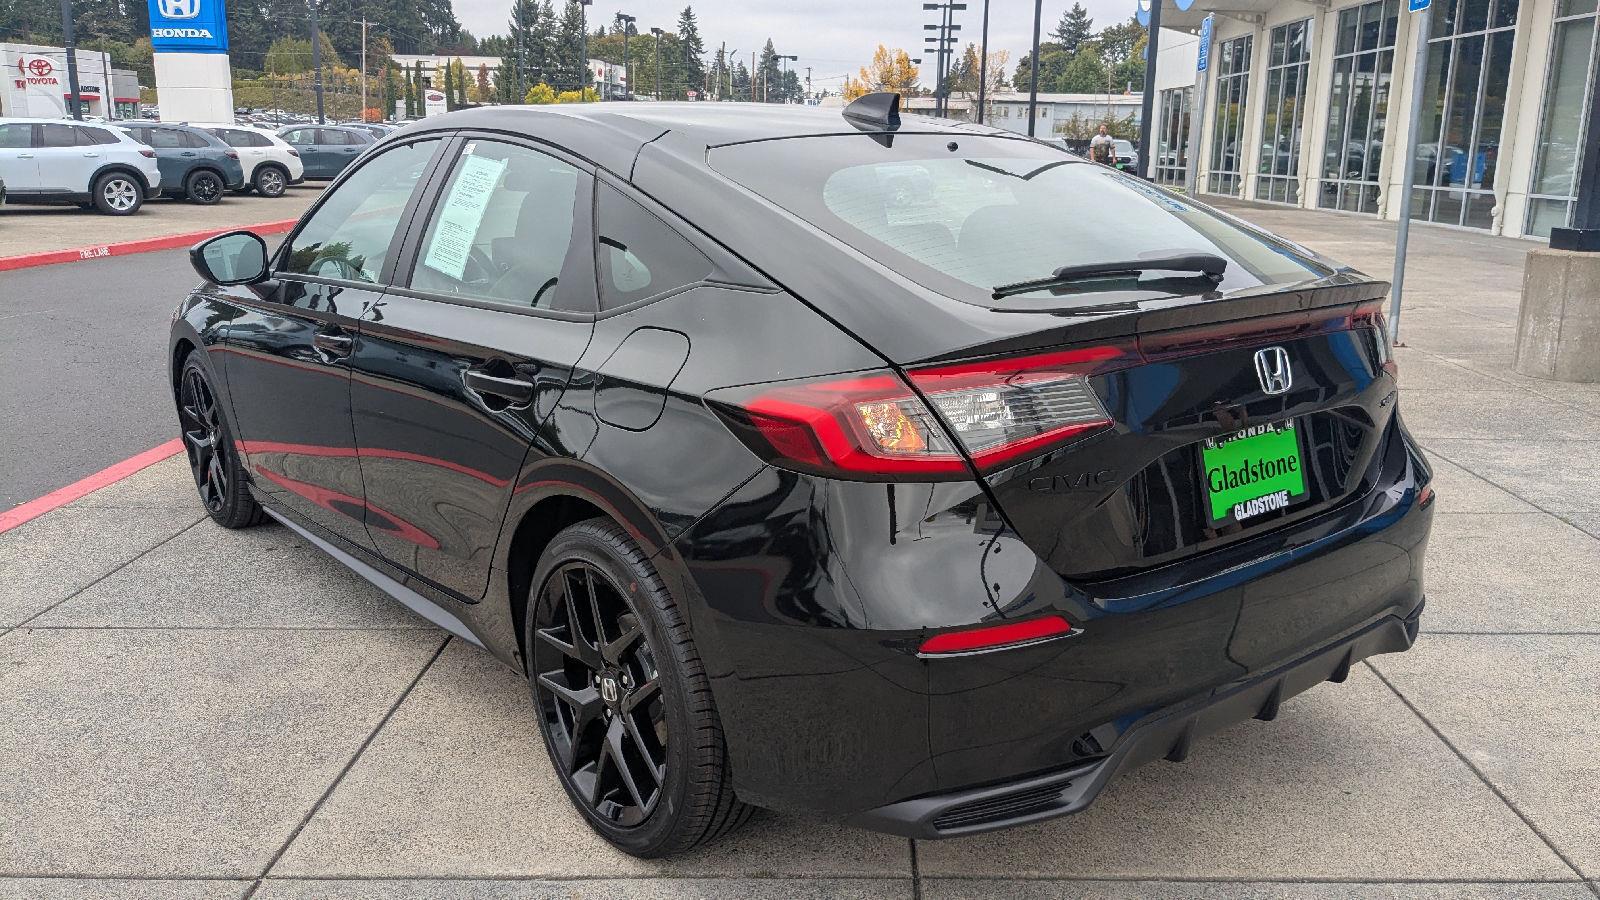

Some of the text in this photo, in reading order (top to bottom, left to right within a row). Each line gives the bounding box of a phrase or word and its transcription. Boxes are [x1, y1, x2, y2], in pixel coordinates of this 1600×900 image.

[152, 28, 213, 39] HONDA
[26, 77, 58, 85] TOYOTA
[80, 247, 110, 259] FIRE LANE
[1228, 422, 1276, 442] ONDA
[1028, 470, 1120, 491] CIVIC
[1207, 454, 1297, 493] Gladstone
[1234, 490, 1289, 520] GLADSTONE
